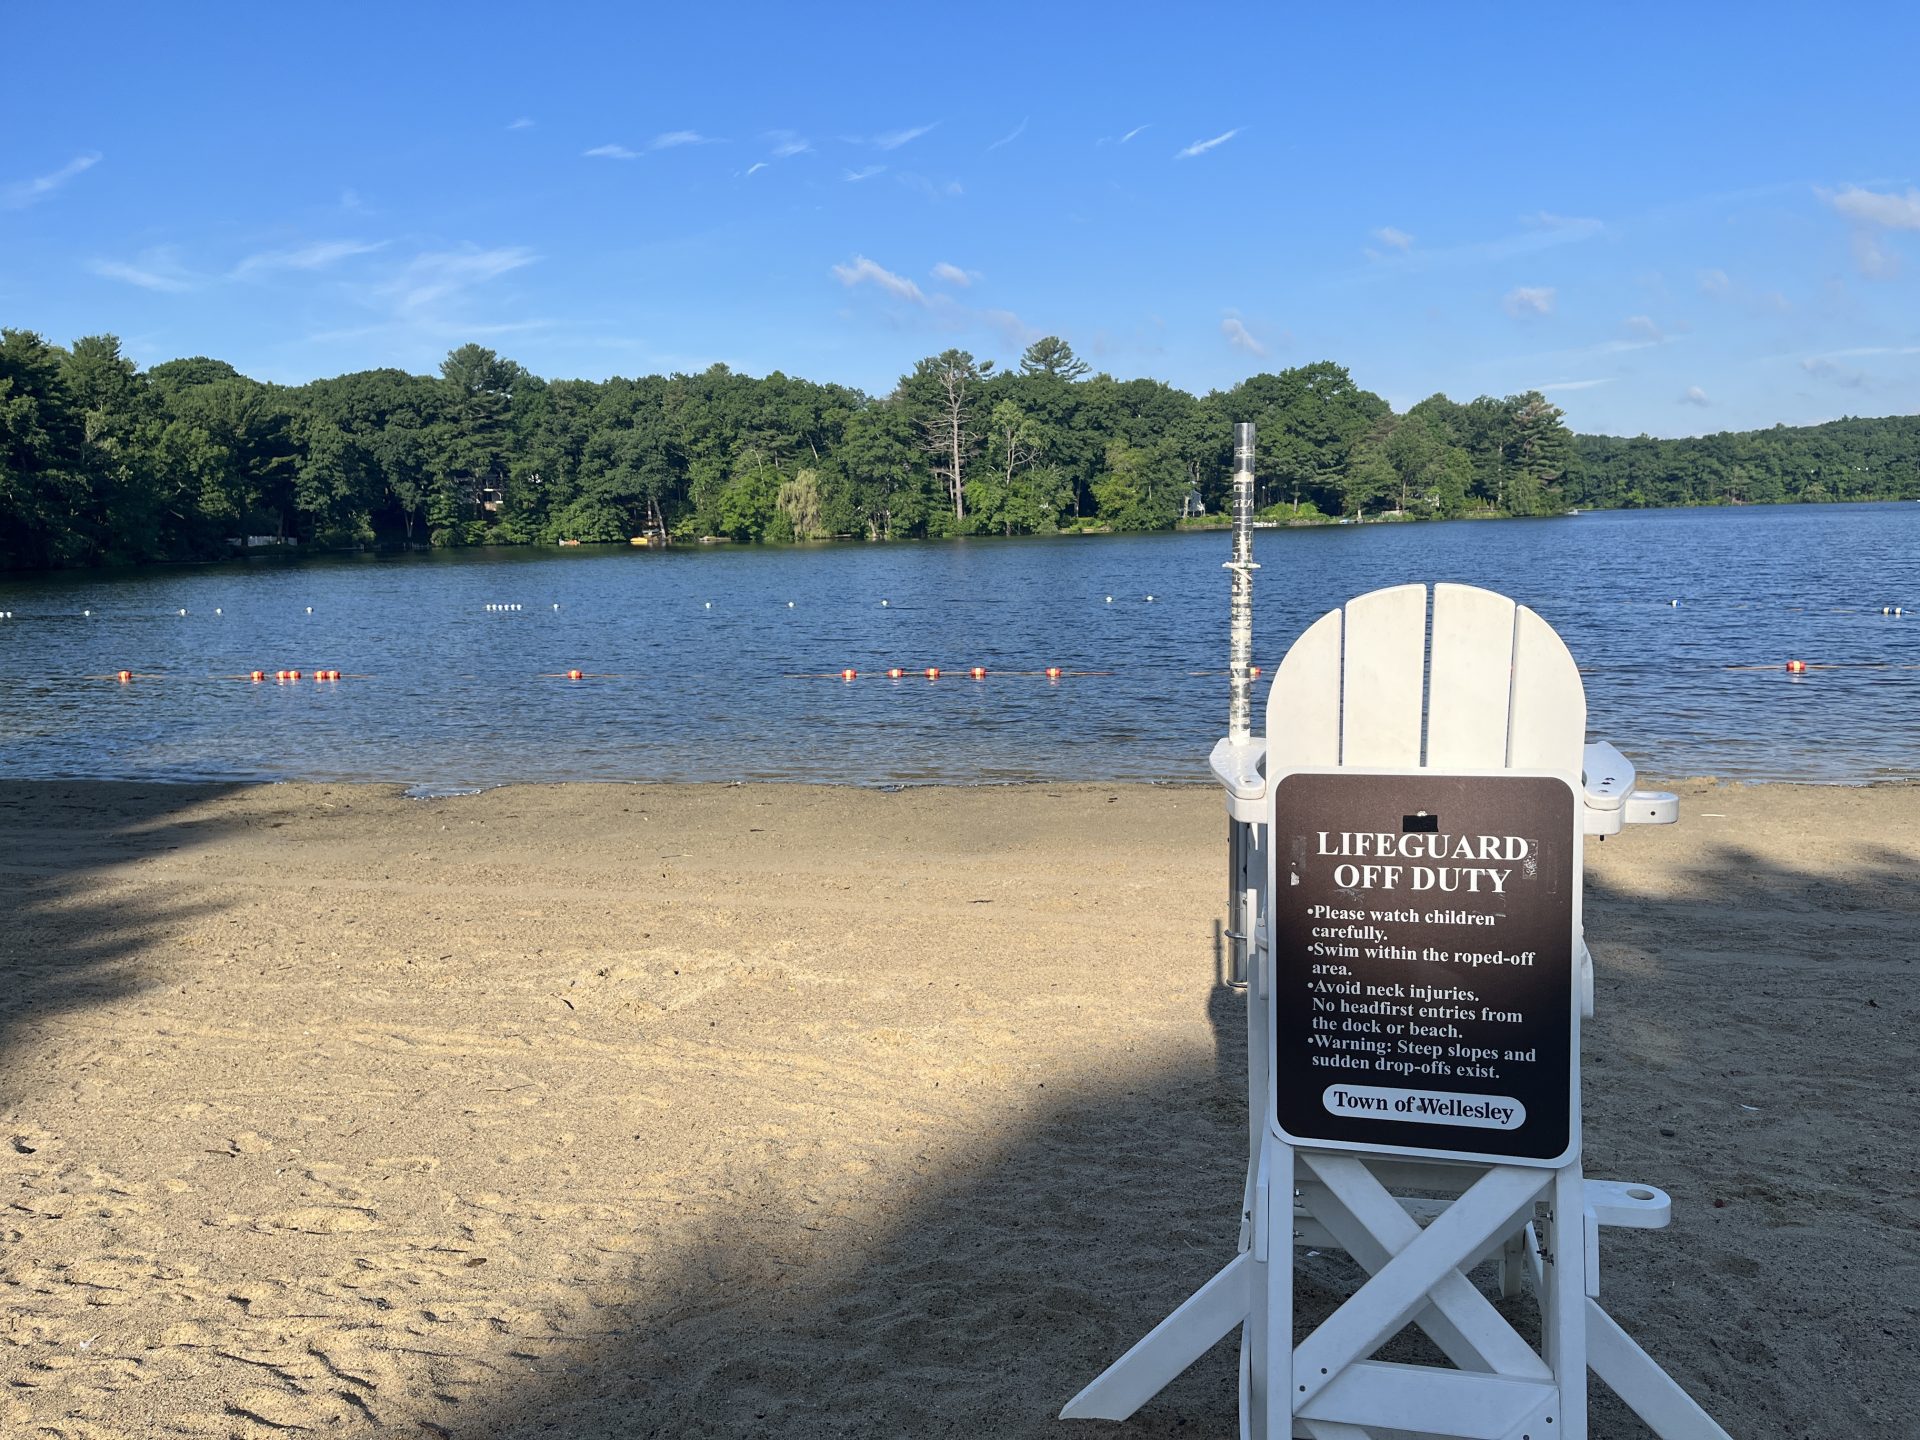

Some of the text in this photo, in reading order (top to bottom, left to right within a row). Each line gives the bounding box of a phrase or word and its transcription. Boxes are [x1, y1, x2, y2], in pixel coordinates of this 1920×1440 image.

[1316, 831, 1529, 860] LIFEGUARD
[1334, 864, 1513, 893] OFF DUTY
[1370, 908, 1420, 923] watch
[1424, 910, 1495, 925] children
[1312, 925, 1388, 943] carefully.
[1364, 945, 1417, 960] within
[1422, 947, 1449, 962] the
[1454, 950, 1536, 967] roped-off
[1312, 963, 1352, 976] area.
[1366, 983, 1405, 997] neck
[1409, 985, 1479, 1003] injuries.
[1312, 998, 1523, 1023] No headfirst entries from
[1312, 1017, 1463, 1038] the dock or beach.
[1397, 1040, 1443, 1058] Steep
[1447, 1044, 1499, 1061] slopes
[1504, 1047, 1536, 1062] and
[1312, 1054, 1500, 1079] sudden drop-offs exist.
[1333, 1091, 1514, 1124] Town of Wellesley
